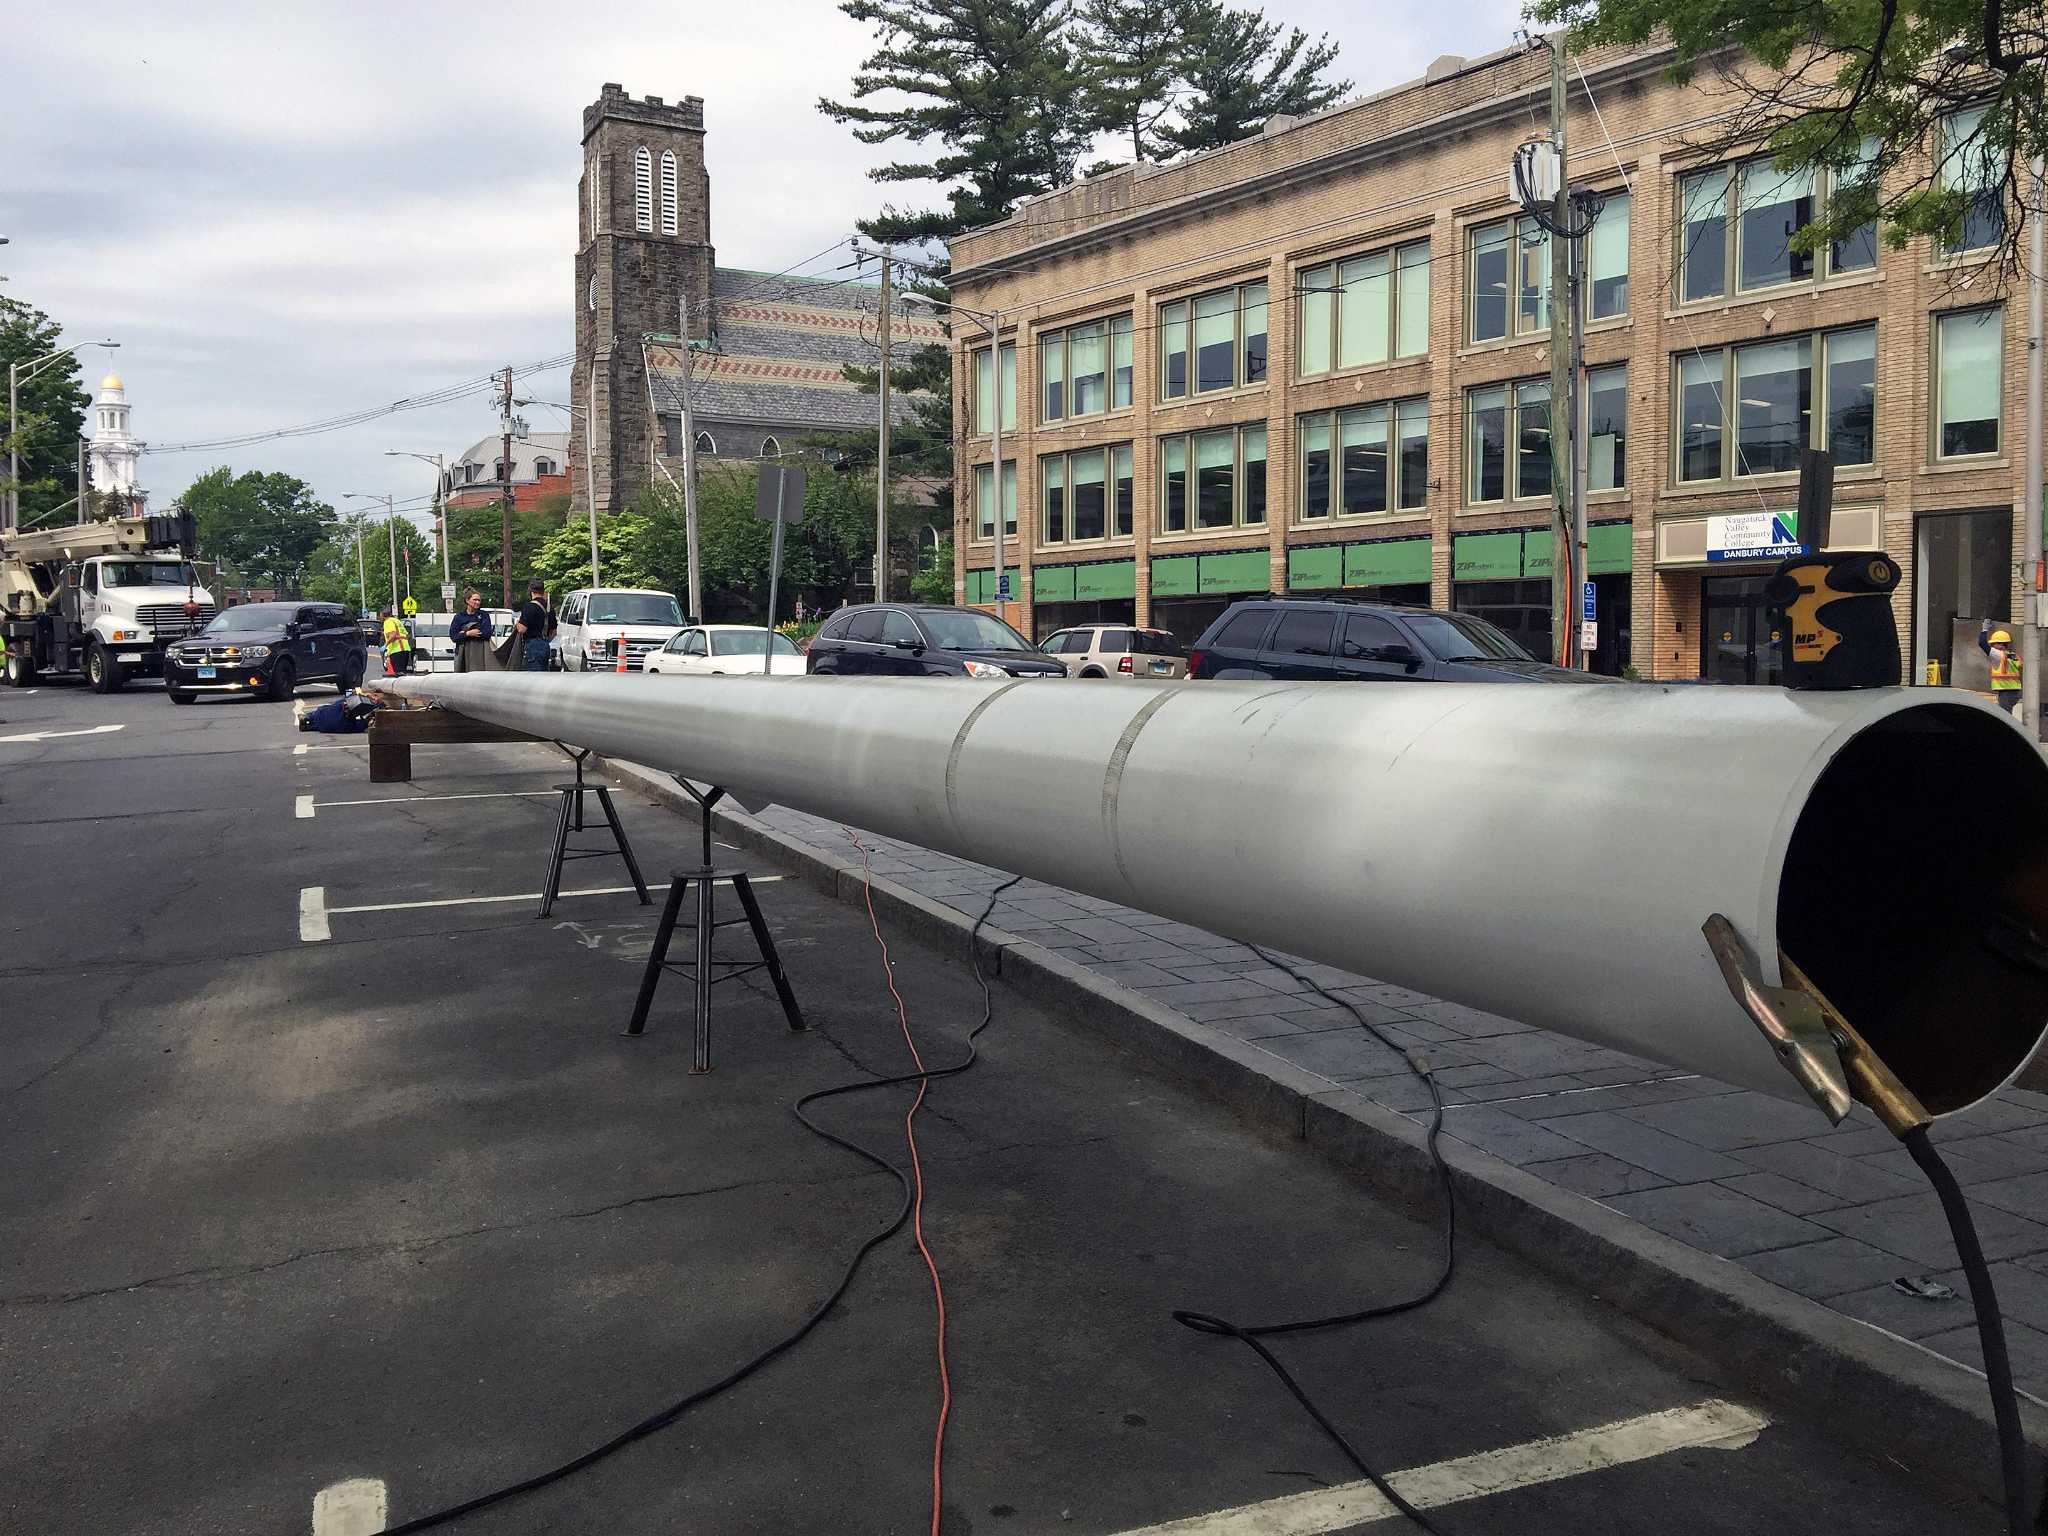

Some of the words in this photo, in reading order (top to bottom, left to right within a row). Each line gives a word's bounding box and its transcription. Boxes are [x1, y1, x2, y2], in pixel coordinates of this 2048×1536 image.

[1724, 524, 1750, 533] Valley
[1724, 530, 1771, 540] Community
[1724, 538, 1755, 548] College
[1723, 548, 1764, 559] DANBURY
[1765, 546, 1802, 557] CAMPUS
